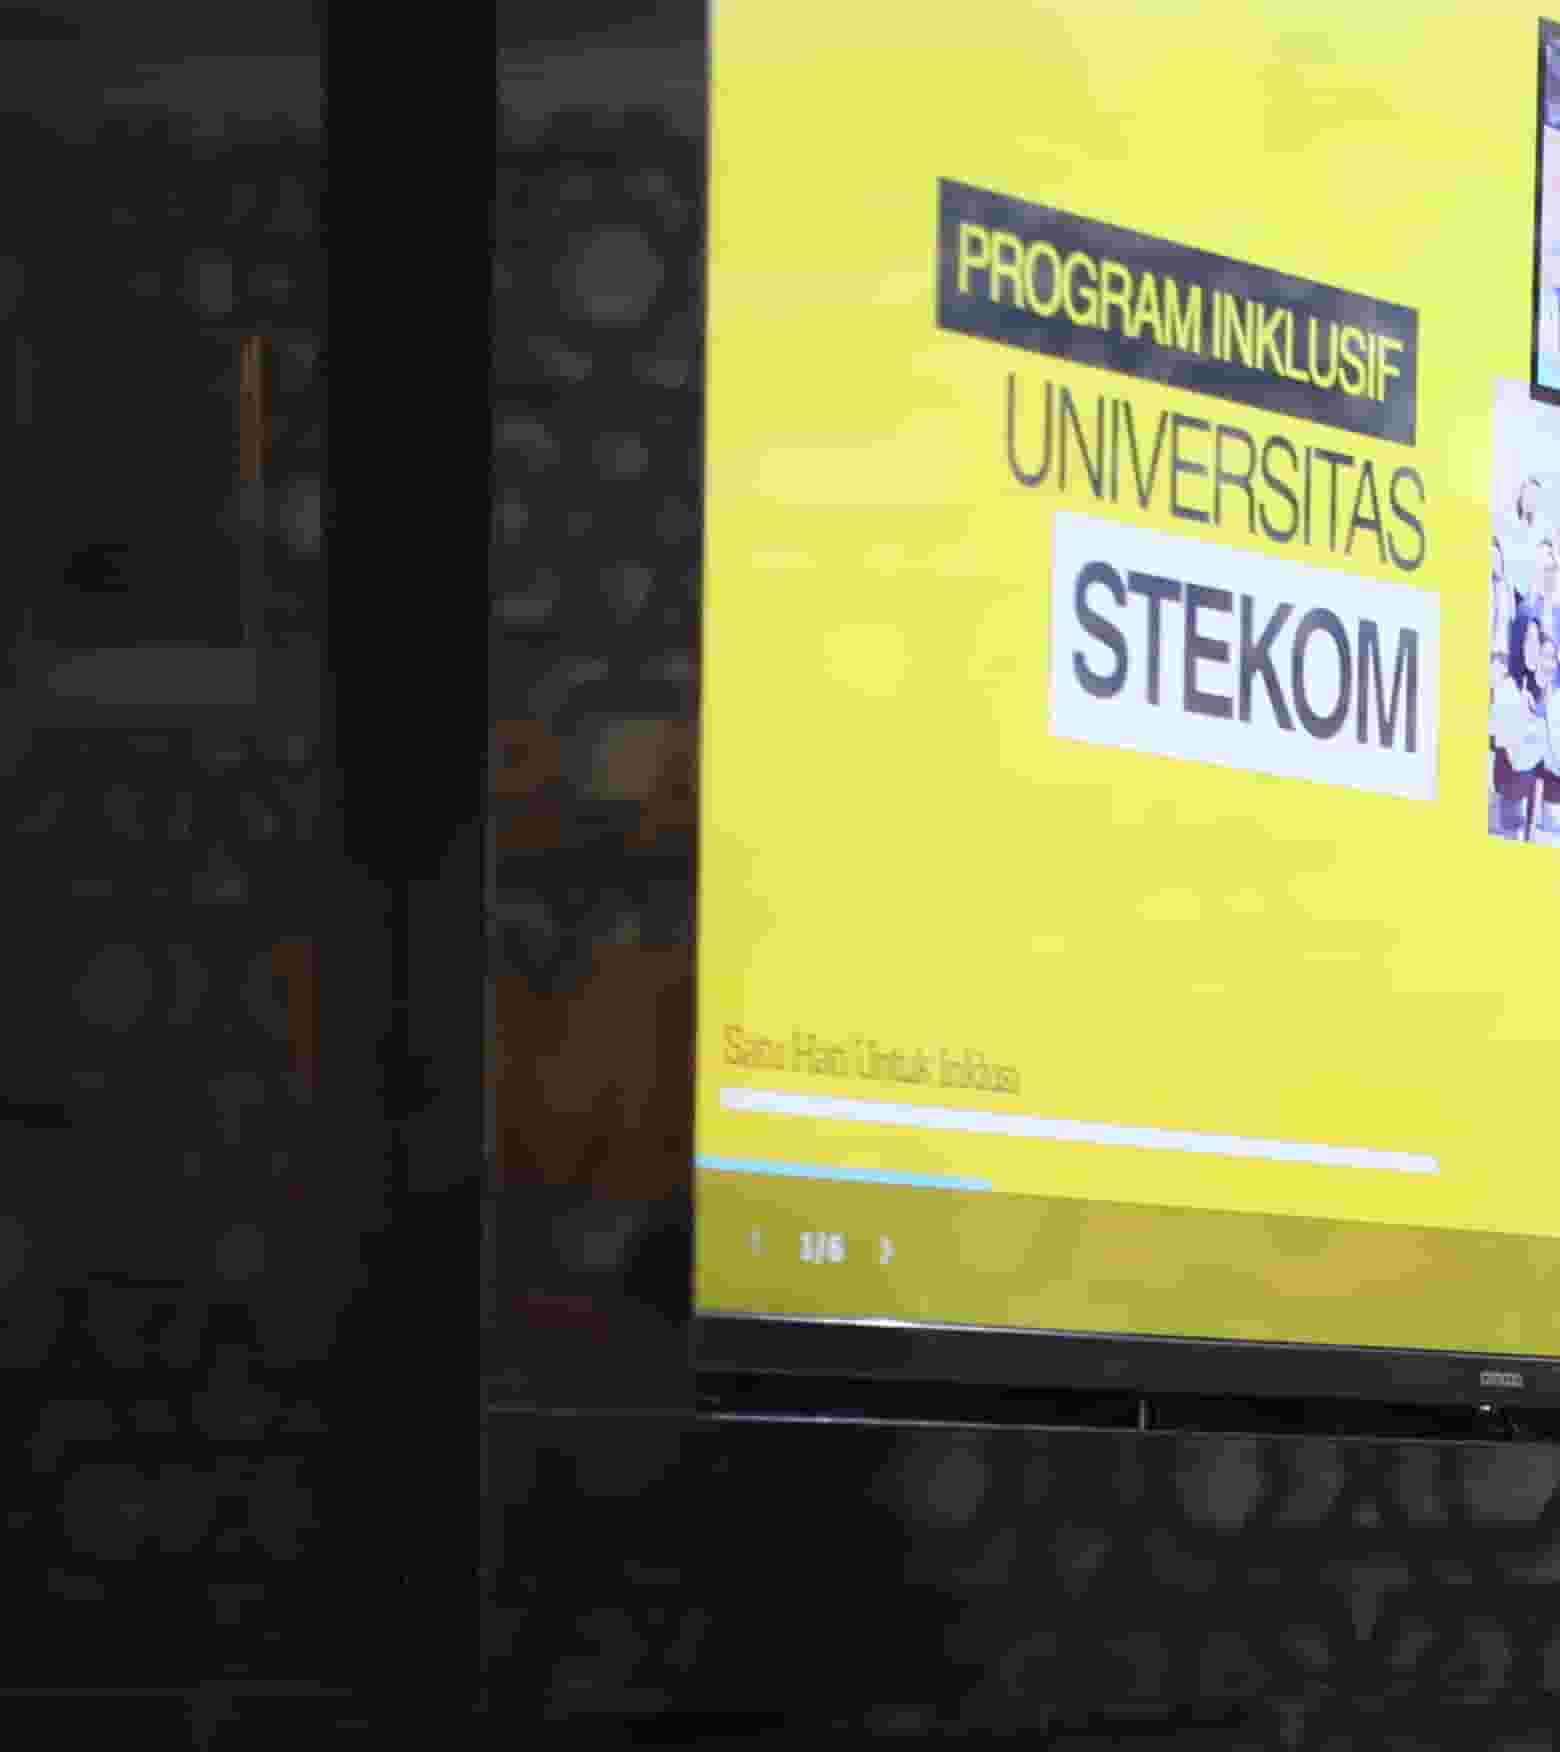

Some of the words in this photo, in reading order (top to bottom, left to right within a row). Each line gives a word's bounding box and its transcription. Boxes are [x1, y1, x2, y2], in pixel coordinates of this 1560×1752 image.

[957, 222, 1203, 356] PROGRAM
[1210, 290, 1406, 402] INKLUSIF
[1004, 371, 1428, 573] UNIVERSITAS
[1071, 559, 1420, 756] STEKOM
